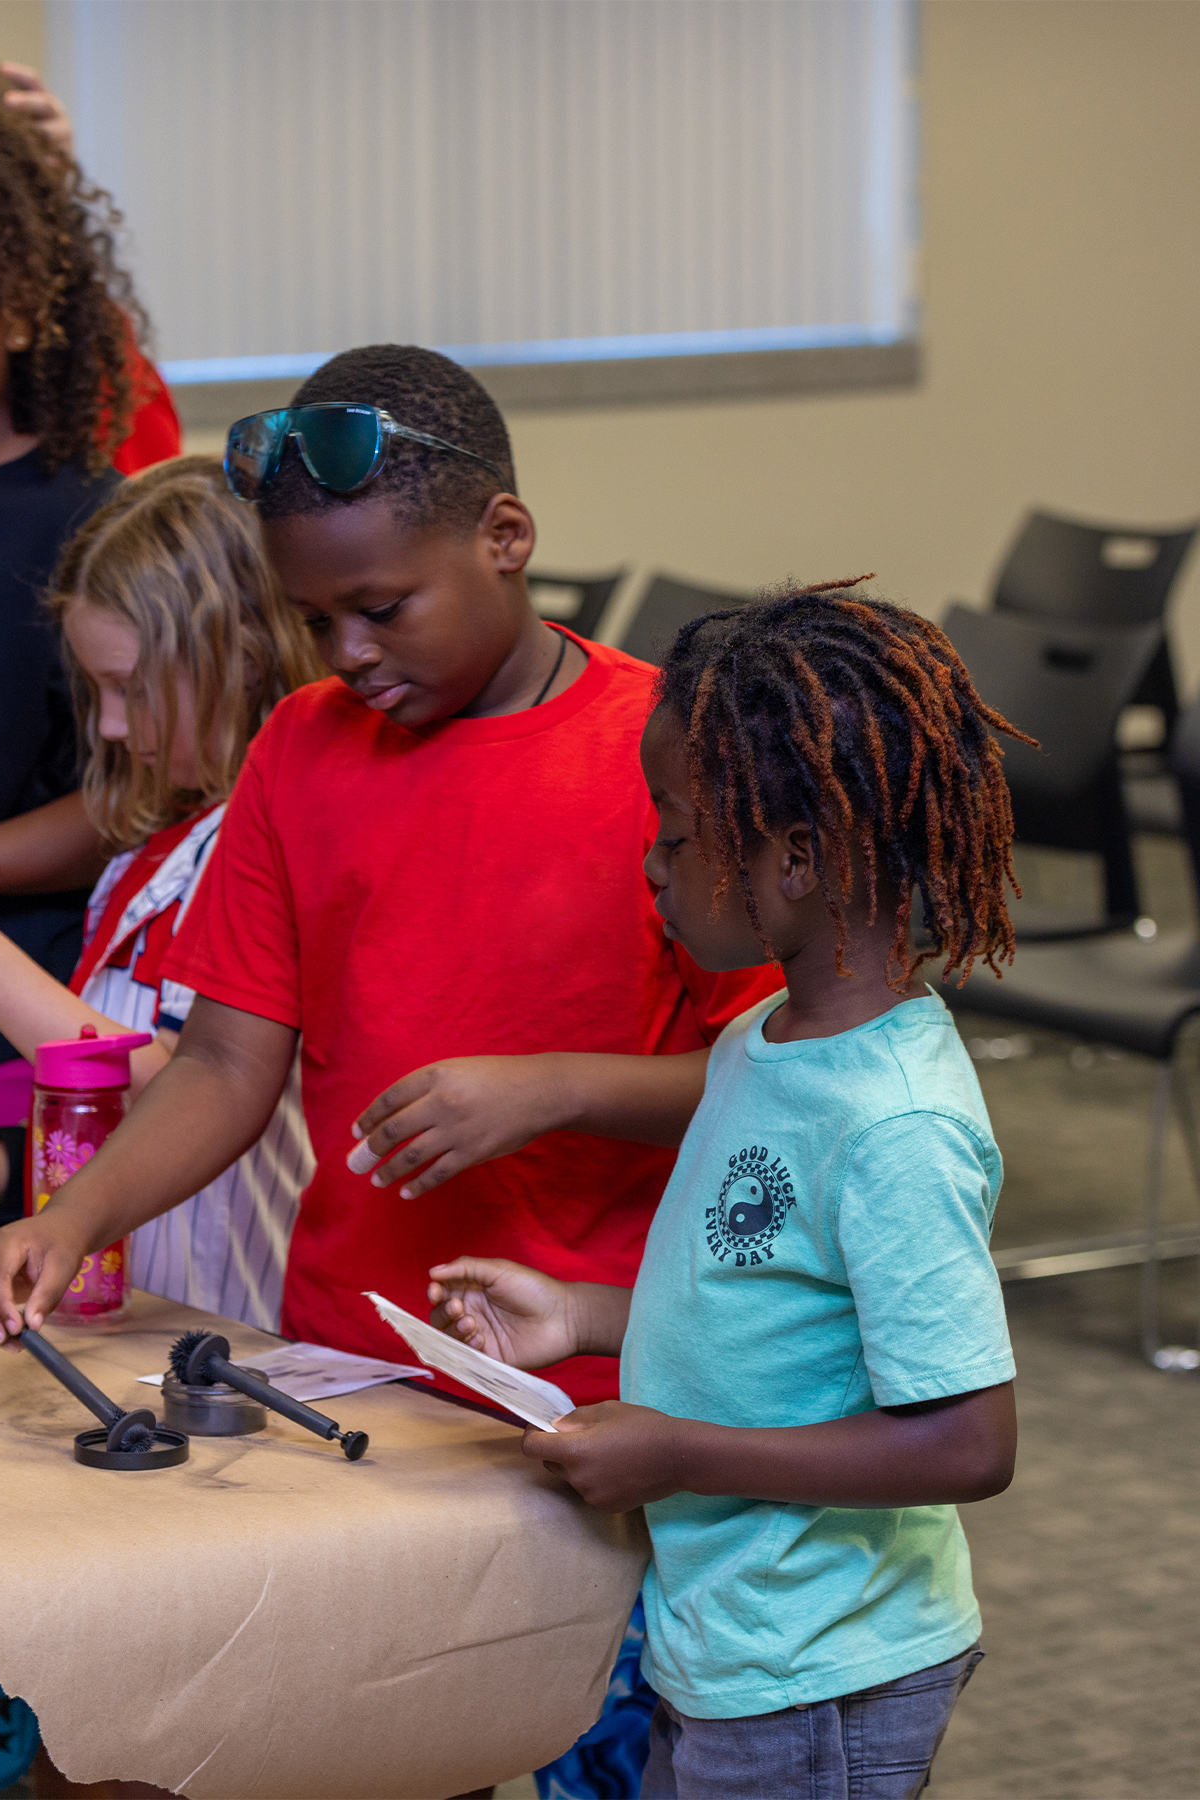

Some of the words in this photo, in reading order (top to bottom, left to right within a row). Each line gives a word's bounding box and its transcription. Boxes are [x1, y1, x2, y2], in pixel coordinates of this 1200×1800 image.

[728, 1145, 768, 1168] GOOD
[770, 1157, 798, 1210] LUCK
[705, 1206, 732, 1262] EVERY
[735, 1243, 775, 1267] DAY
